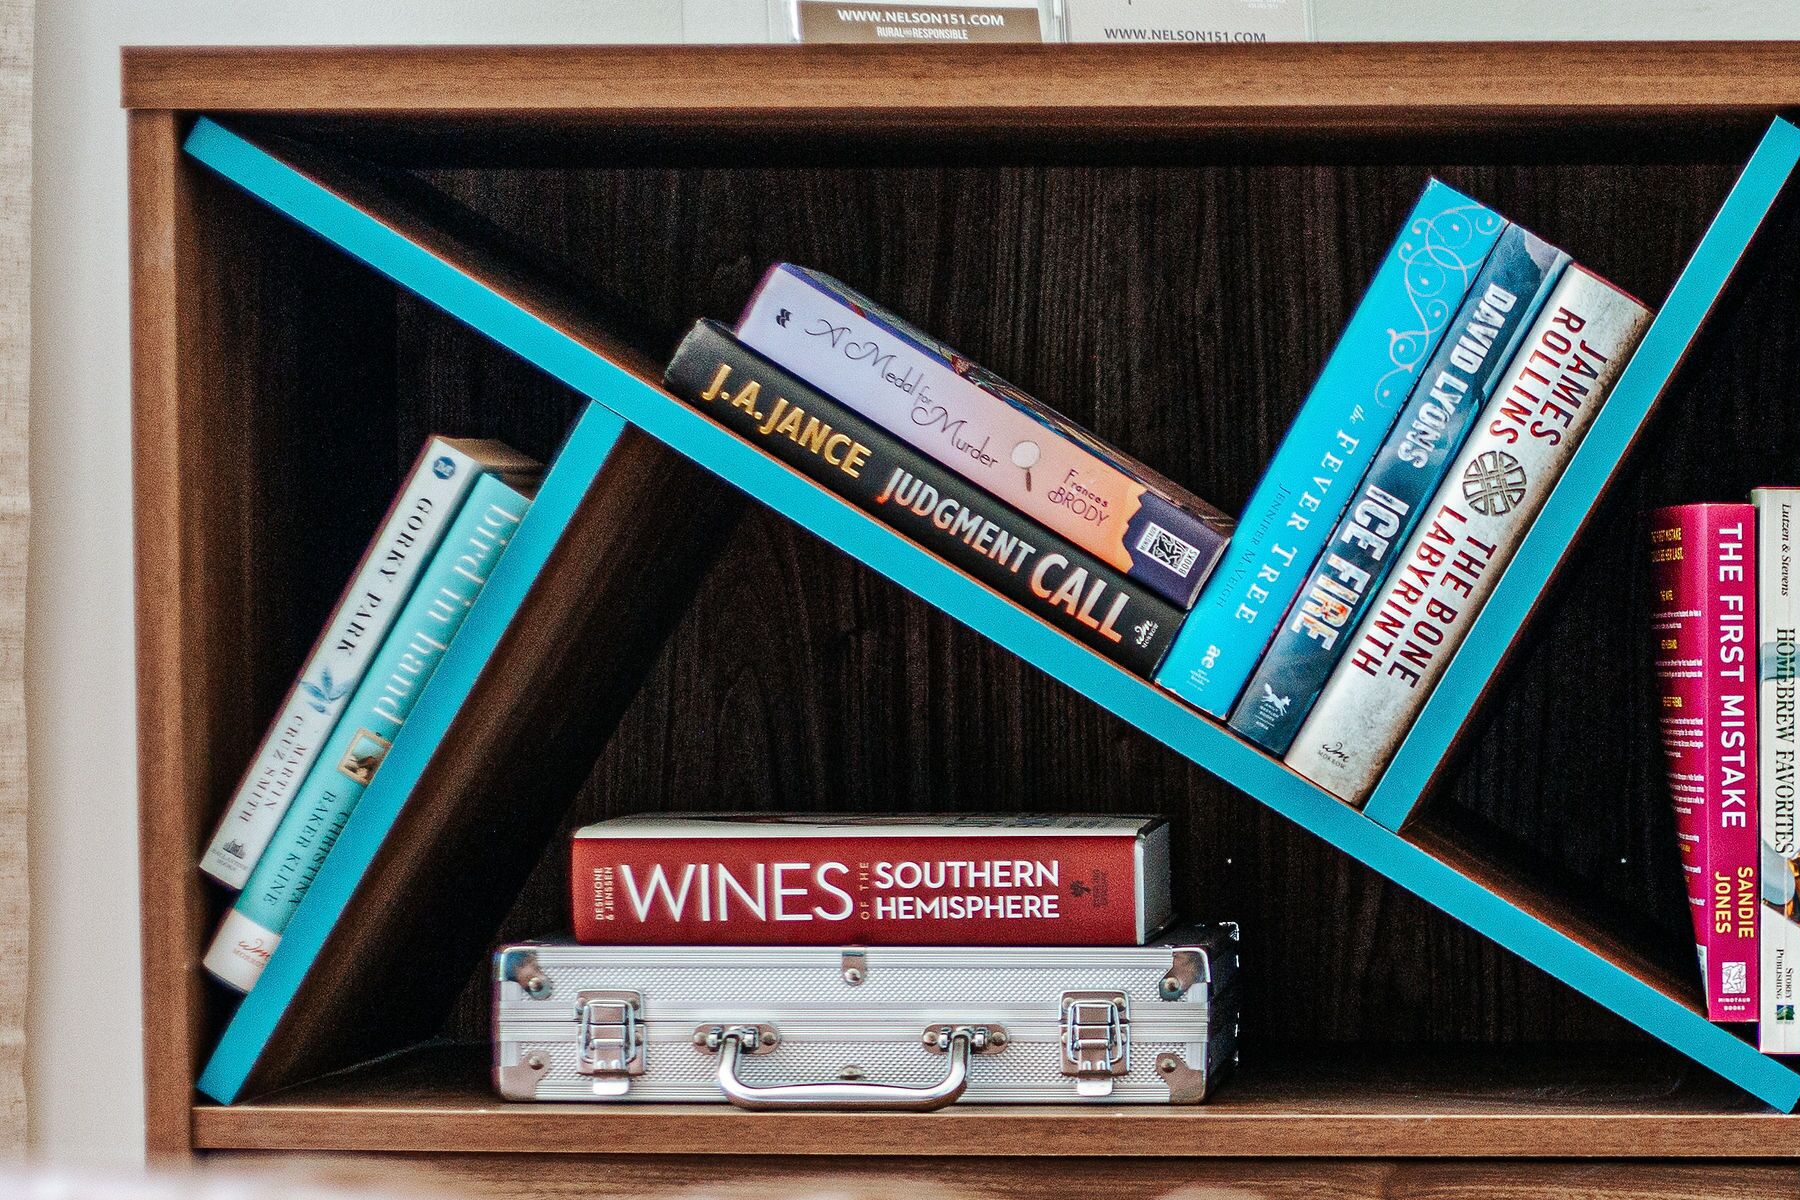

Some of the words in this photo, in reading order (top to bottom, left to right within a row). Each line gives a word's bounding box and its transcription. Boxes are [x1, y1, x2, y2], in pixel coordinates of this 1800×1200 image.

[837, 9, 1004, 26] WWW.NELSON151.COM
[877, 26, 904, 38] RURAL
[912, 27, 968, 40] RESPONSIBLE
[1103, 28, 1266, 43] WWW.NELSON151.COM
[1449, 282, 1518, 376] DAVID
[845, 342, 916, 396] Medal
[911, 406, 998, 469] Murder
[1489, 306, 1587, 445] ROLLINS
[1530, 338, 1608, 447] JAMES
[760, 397, 871, 479] JANCE
[1349, 404, 1366, 425] the
[1397, 371, 1470, 470] LYONS
[1048, 486, 1109, 526] BRODY
[1068, 469, 1109, 508] Frances
[1286, 429, 1360, 532] FEVER
[379, 497, 433, 583] GORKY
[452, 503, 521, 584] bird
[1340, 484, 1411, 563] ICE
[1718, 523, 1743, 582] THE
[1781, 503, 1792, 542] Lutzen
[1781, 544, 1790, 552] &
[877, 467, 1036, 574] JUDGMENT
[1030, 552, 1132, 643] CALL
[1179, 550, 1198, 575] BOOKS
[1235, 543, 1298, 624] TREE
[1440, 535, 1497, 599] THE
[1781, 554, 1791, 597] Stevens
[428, 588, 471, 622] in
[1290, 554, 1372, 653] FIRE
[1351, 504, 1467, 676] LABYRINTH
[337, 592, 382, 656] PARK
[1141, 622, 1159, 649] MORROW
[1387, 604, 1458, 688] BONE
[1719, 595, 1744, 683] FIRST
[373, 631, 448, 725] hand
[1775, 627, 1796, 744] HOMEBREW
[273, 715, 304, 761] CRUZ
[1720, 695, 1747, 828] MISTAKE
[239, 766, 276, 823] SMITH
[264, 745, 307, 810] MARTIN
[1775, 748, 1795, 855] FAVORITES
[296, 790, 337, 848] BAKER
[264, 852, 301, 906] KLINE
[593, 867, 604, 921] DESIMONE
[604, 866, 614, 912] JENSSEN
[620, 862, 854, 923] WINES
[859, 861, 870, 891] THE
[874, 860, 1059, 889] SOUTHERN
[1714, 871, 1732, 934] JONES
[1737, 867, 1754, 938] SANDIE
[860, 901, 870, 921] OF
[876, 895, 1060, 920] HEMISPHERE
[1776, 949, 1784, 1000] PUBLISHING
[1784, 967, 1793, 1000] STOREY
